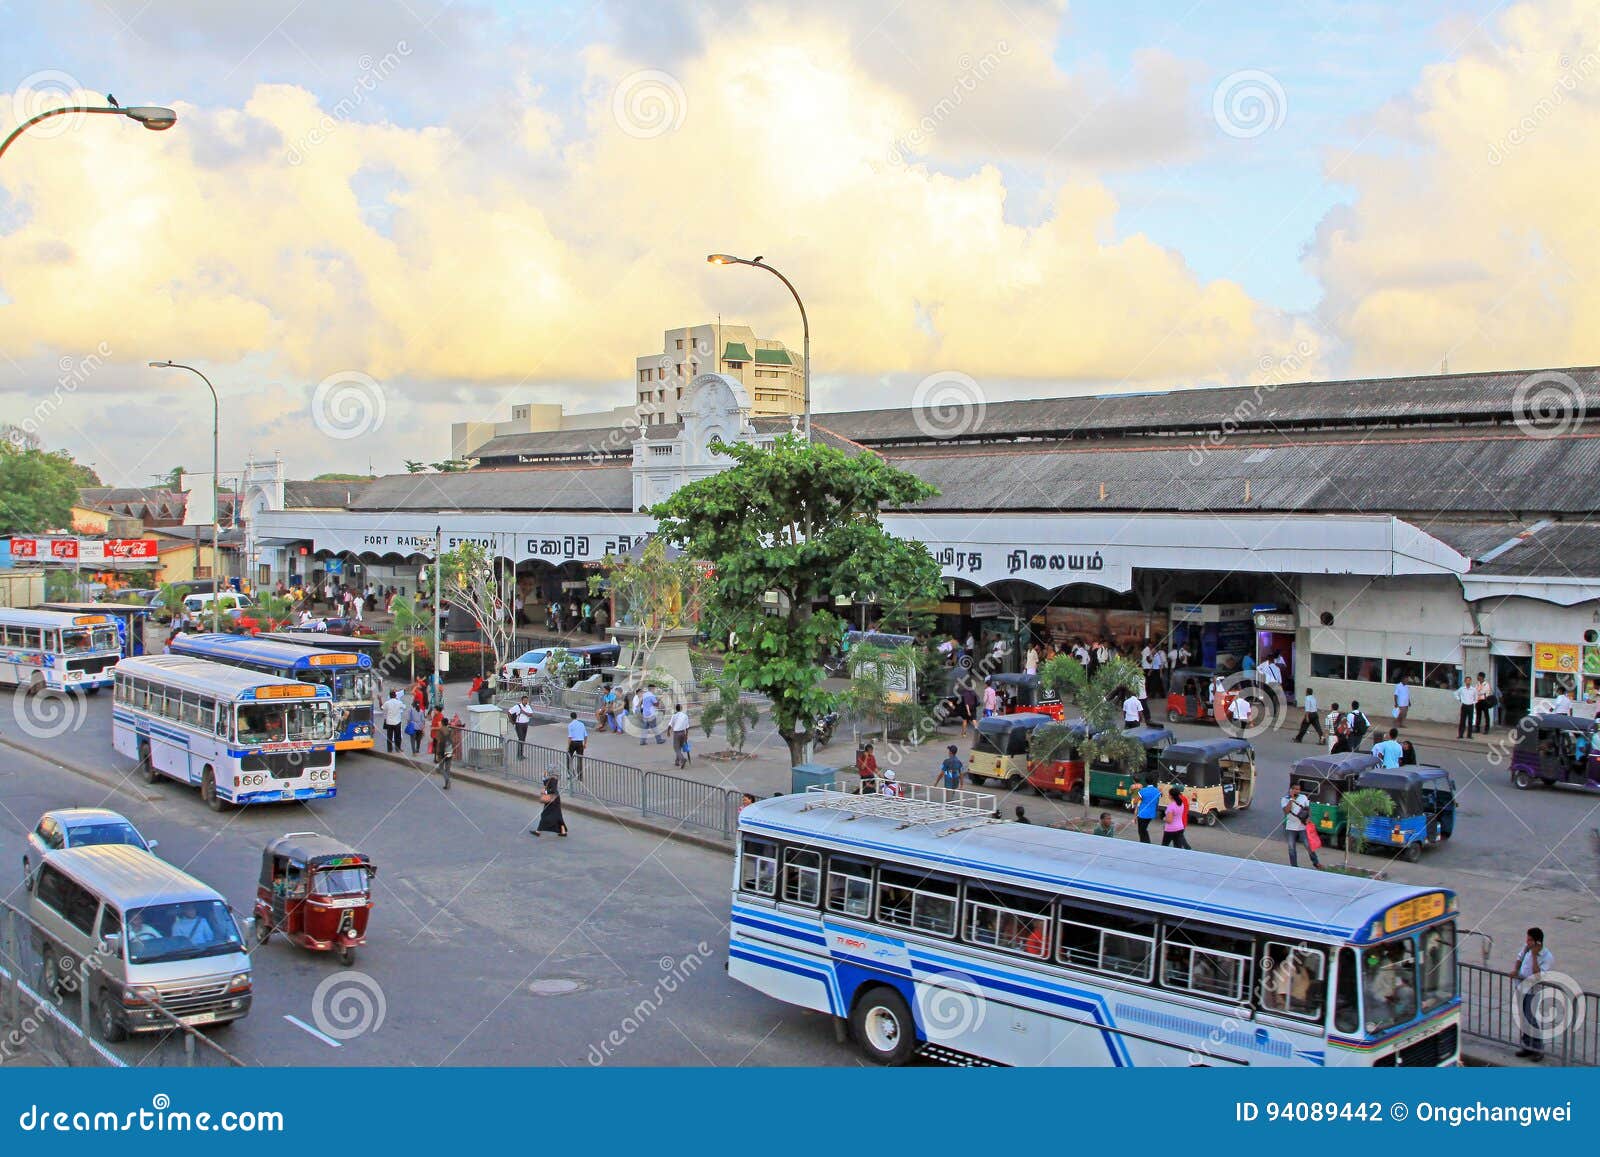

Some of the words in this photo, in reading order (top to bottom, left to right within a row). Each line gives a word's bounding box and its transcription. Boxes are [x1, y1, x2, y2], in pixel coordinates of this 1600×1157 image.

[364, 536, 388, 545] FORT
[397, 536, 436, 546] RAIL
[449, 538, 497, 549] STTION
[1007, 549, 1104, 574] நிலையம்
